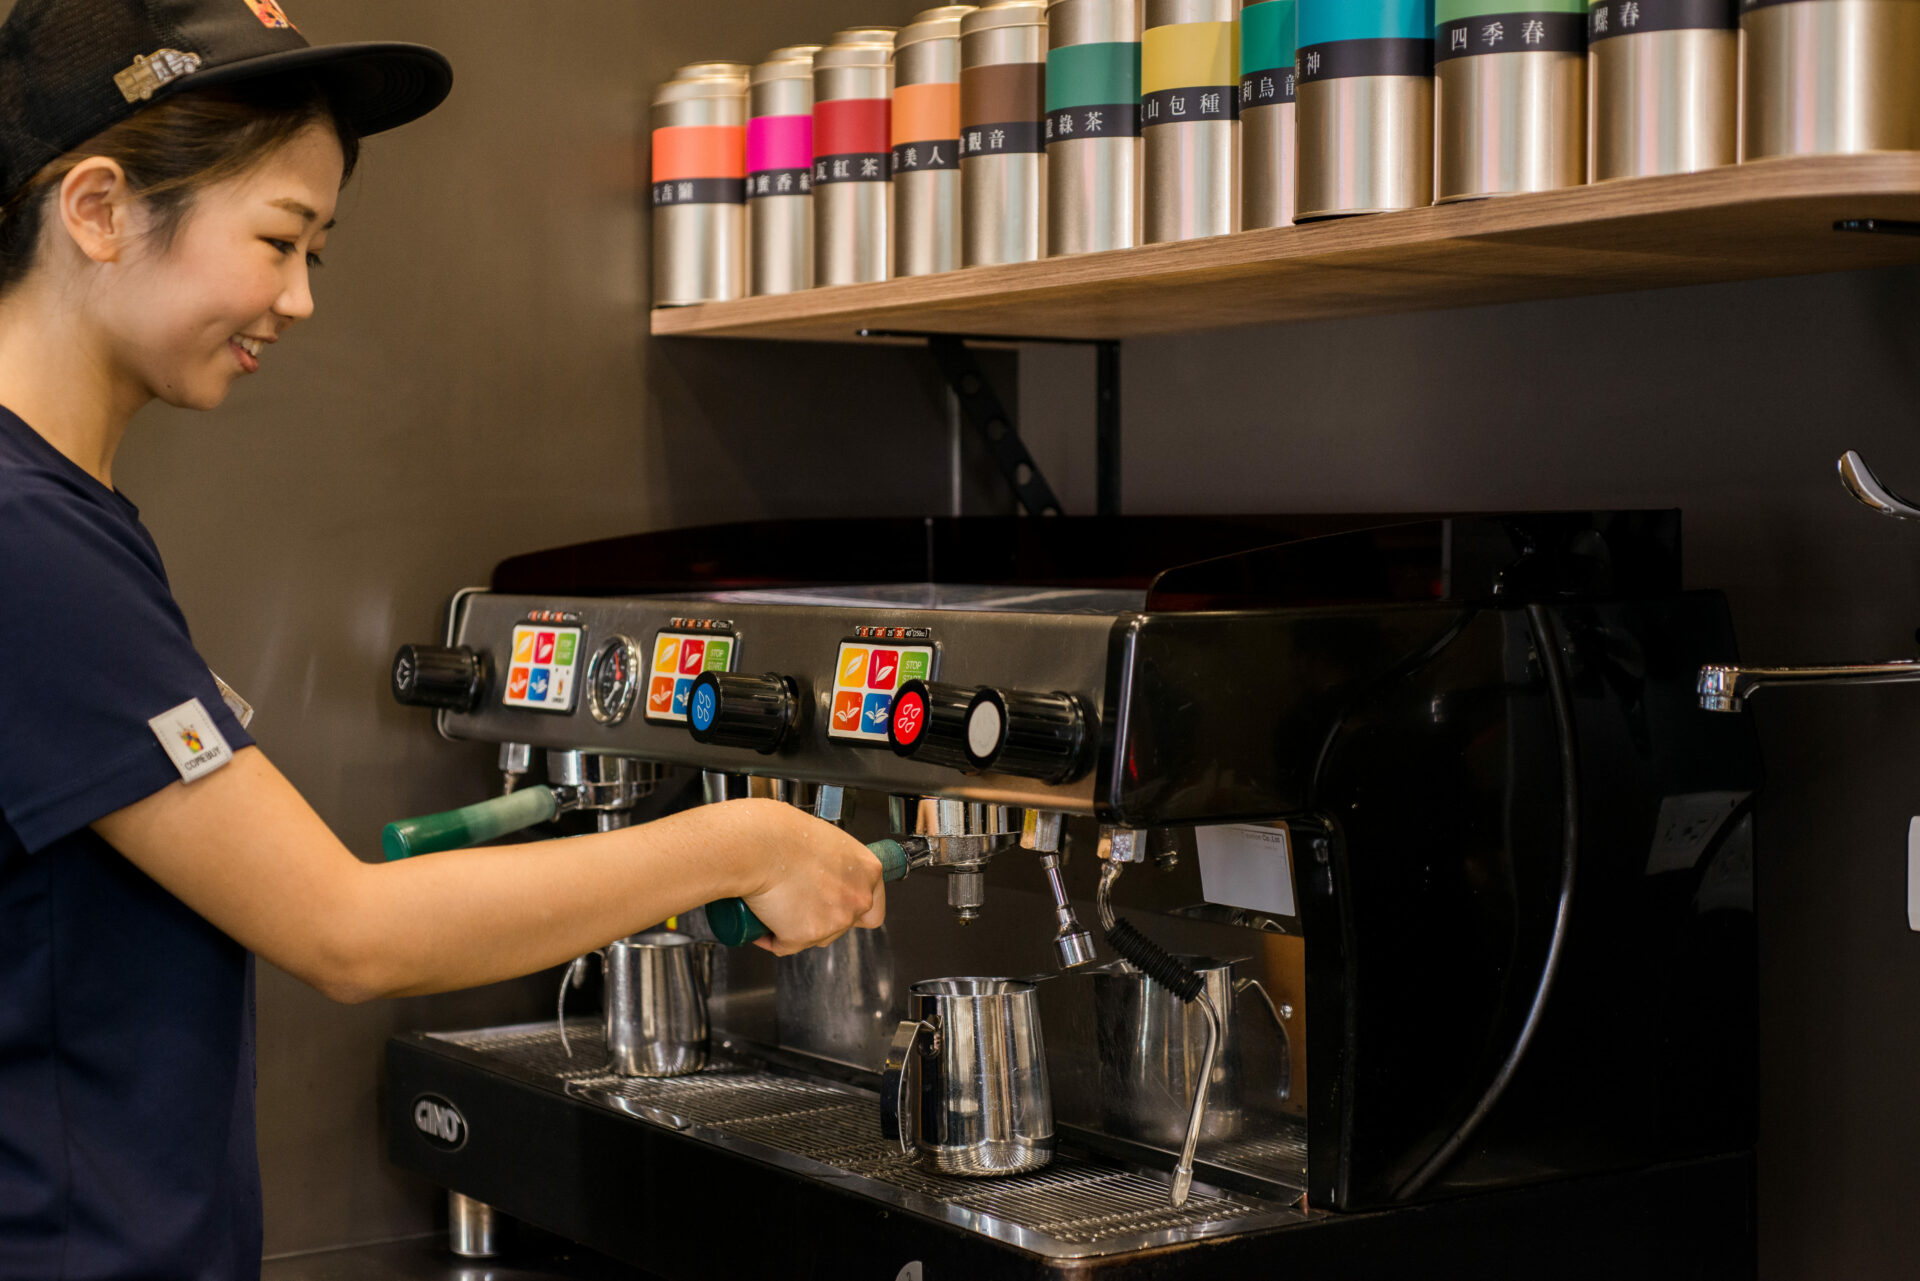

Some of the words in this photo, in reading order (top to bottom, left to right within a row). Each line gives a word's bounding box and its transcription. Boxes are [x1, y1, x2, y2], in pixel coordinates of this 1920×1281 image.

[1590, 1, 1640, 34] 螺春
[1451, 19, 1545, 51] 四季春
[1239, 75, 1295, 104] 莉烏龍
[1140, 92, 1221, 123] 山包種
[906, 660, 922, 669] STOP
